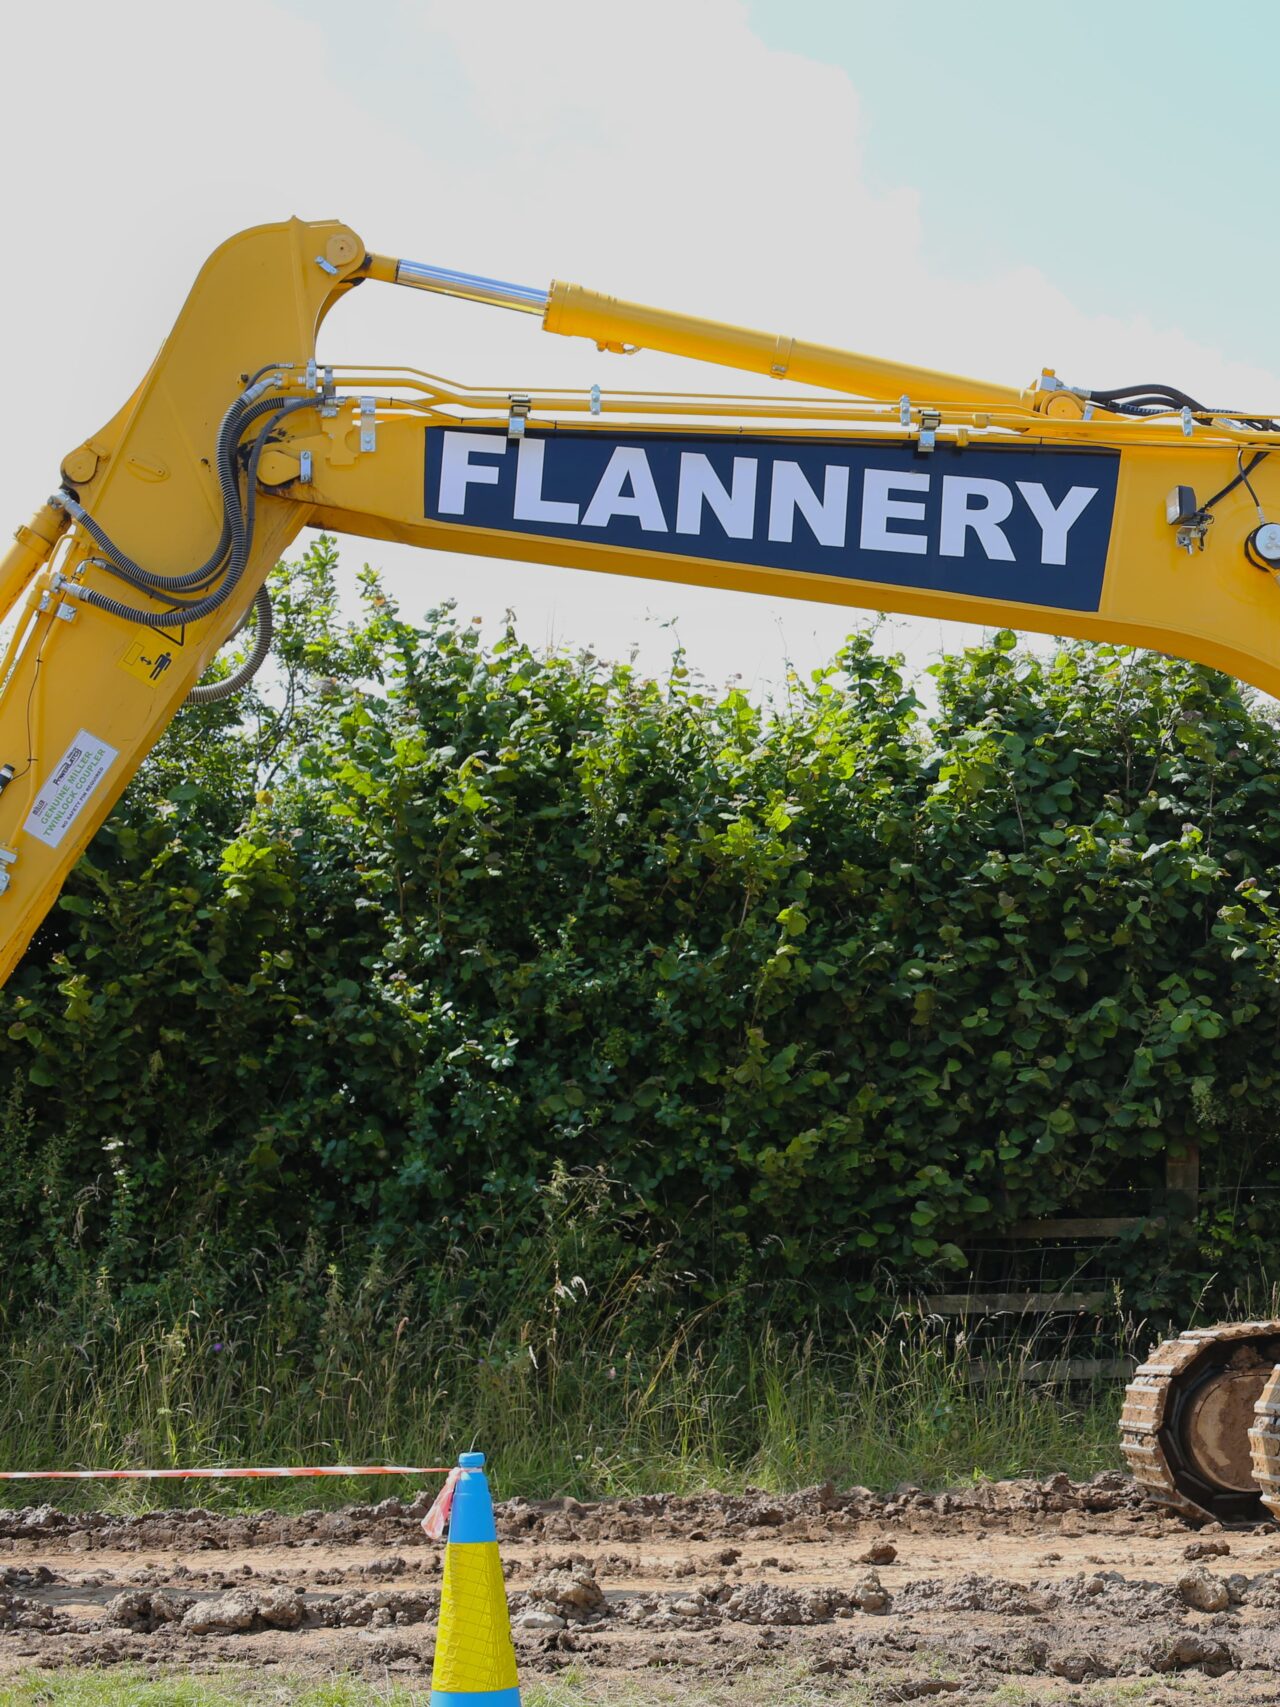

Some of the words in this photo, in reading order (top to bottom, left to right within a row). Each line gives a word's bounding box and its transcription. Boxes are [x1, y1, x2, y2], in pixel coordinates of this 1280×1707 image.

[437, 430, 1099, 566] FLANNERY
[41, 784, 70, 825] GENUINE
[67, 751, 94, 784] MILLER
[43, 791, 78, 836] TWINLOCK
[75, 748, 106, 790] COUPLER
